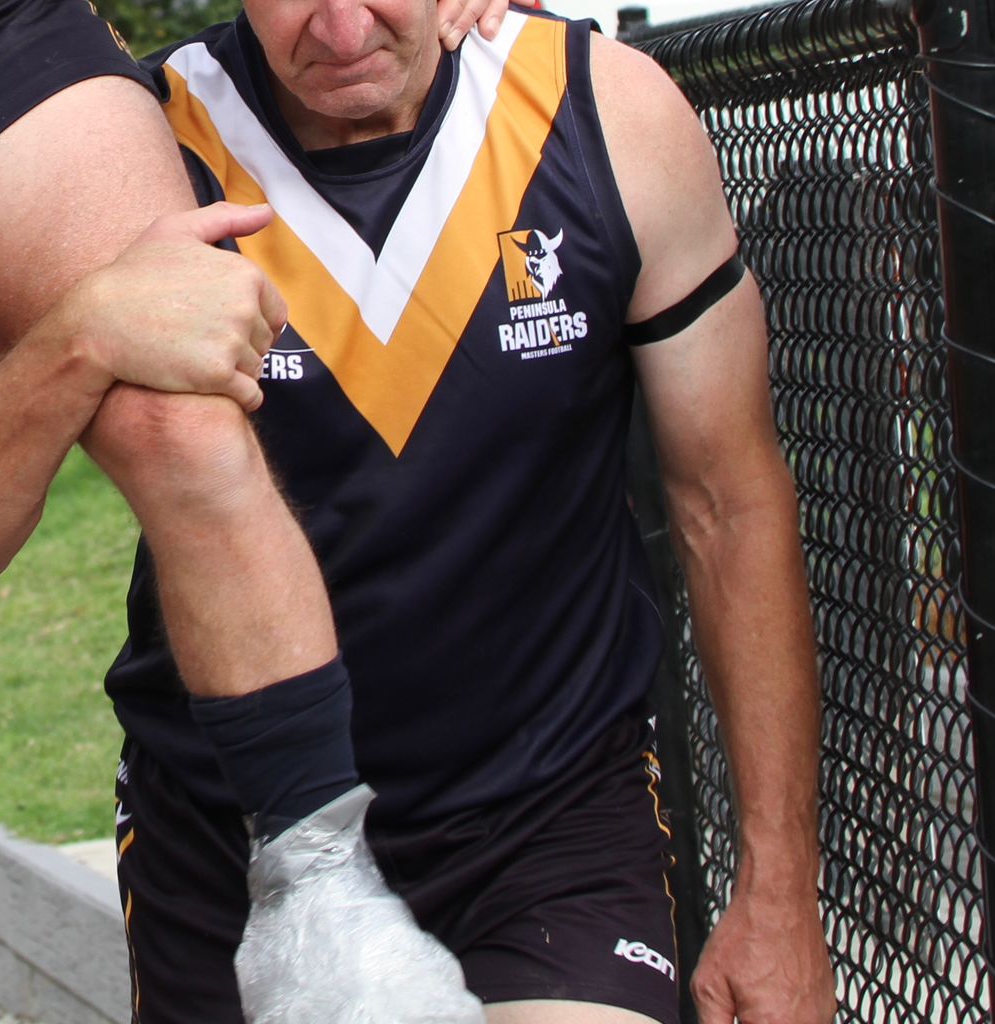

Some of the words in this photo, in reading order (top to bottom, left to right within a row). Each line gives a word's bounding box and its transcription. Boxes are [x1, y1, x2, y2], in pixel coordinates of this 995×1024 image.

[509, 298, 567, 321] PENINSULA
[498, 311, 588, 352] RAIDERS
[261, 353, 304, 380] ERS
[521, 349, 548, 360] MASTERS
